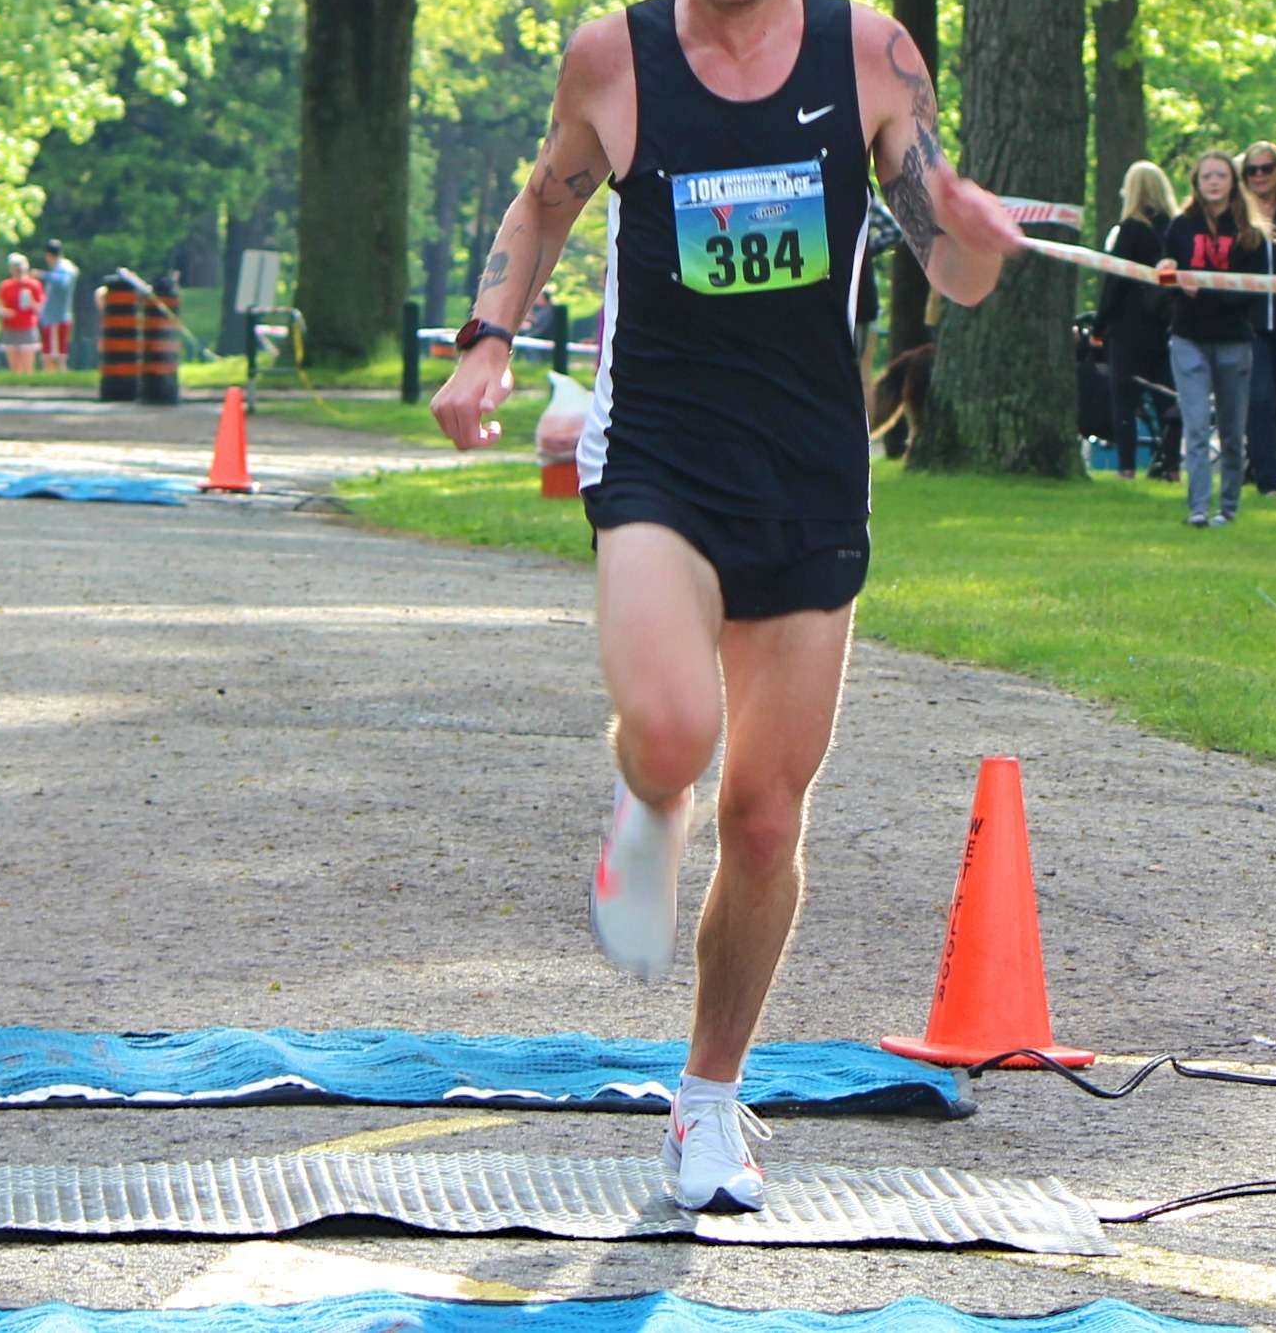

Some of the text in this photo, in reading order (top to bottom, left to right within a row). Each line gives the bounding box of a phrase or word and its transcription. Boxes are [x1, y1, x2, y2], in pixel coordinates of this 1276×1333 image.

[687, 177, 723, 203] 10K
[706, 229, 804, 287] 384
[937, 818, 984, 1002] WET FLOOR
